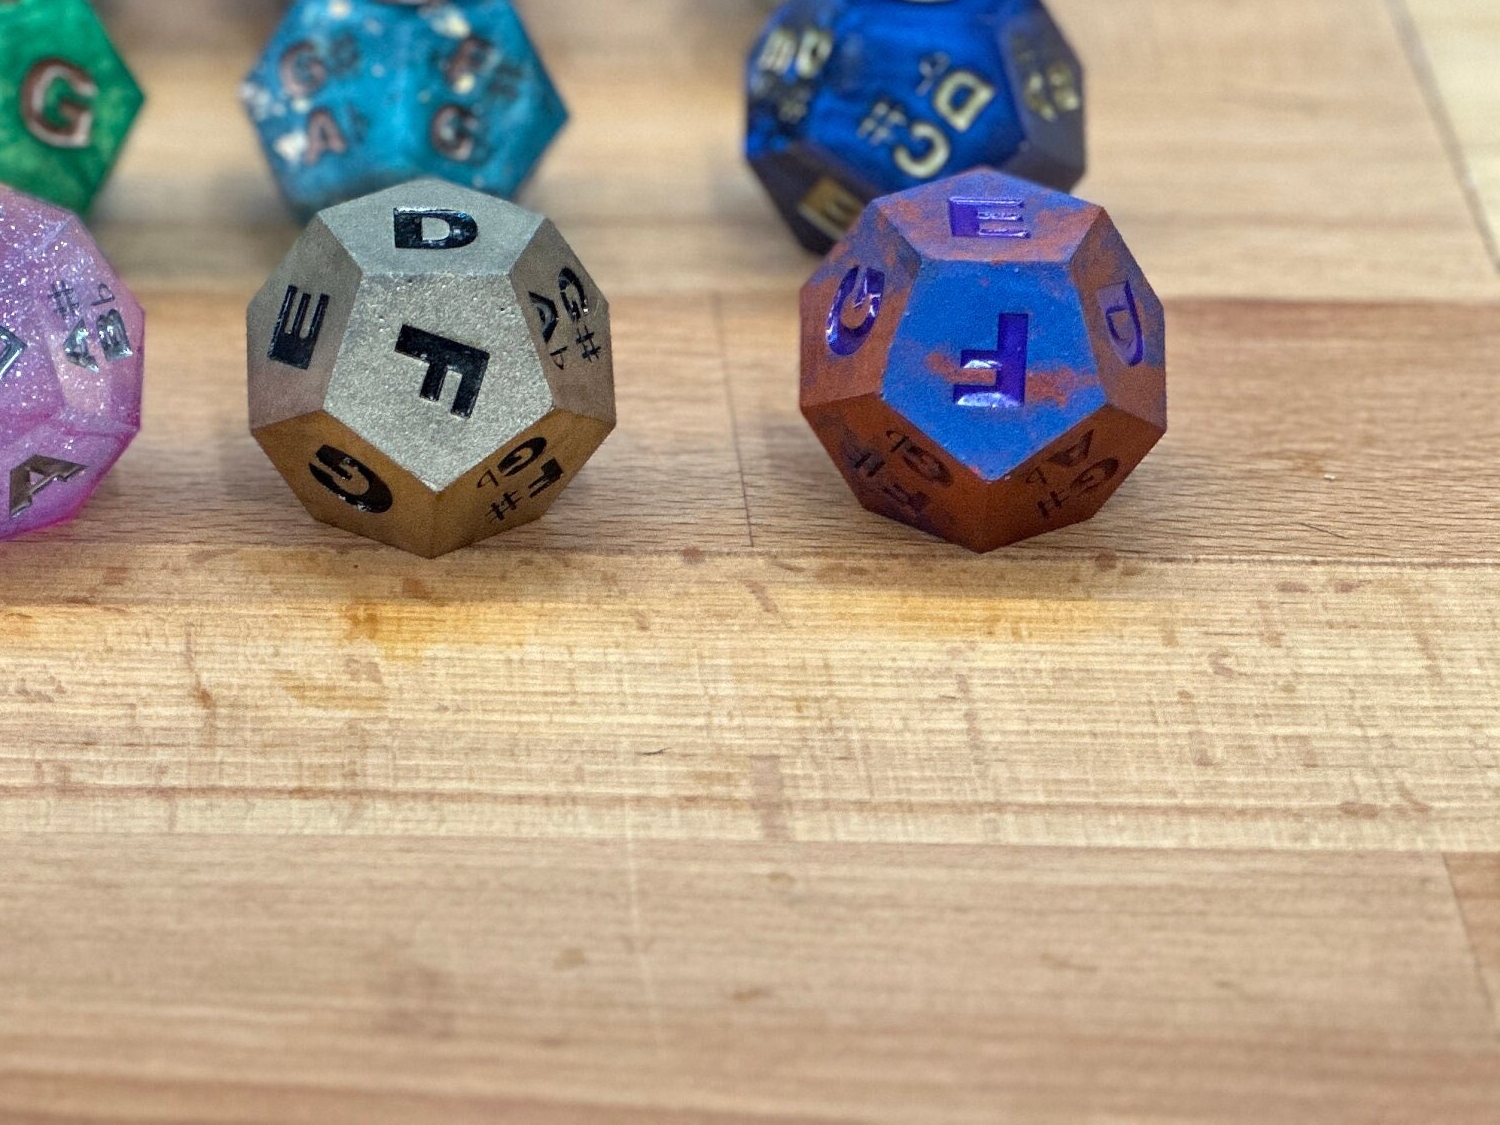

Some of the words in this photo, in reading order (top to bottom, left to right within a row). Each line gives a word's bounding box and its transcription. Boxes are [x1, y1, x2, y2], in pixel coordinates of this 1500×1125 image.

[20, 57, 99, 150] G
[393, 207, 479, 250] D
[947, 195, 1032, 239] E
[47, 280, 101, 373] A#
[266, 284, 331, 371] E
[557, 266, 602, 364] G#
[824, 265, 886, 357] G
[1098, 278, 1145, 368] D
[393, 323, 491, 420] F
[952, 311, 1030, 409] F
[8, 453, 90, 519] A
[308, 443, 394, 514] G
[485, 457, 566, 525] F#
